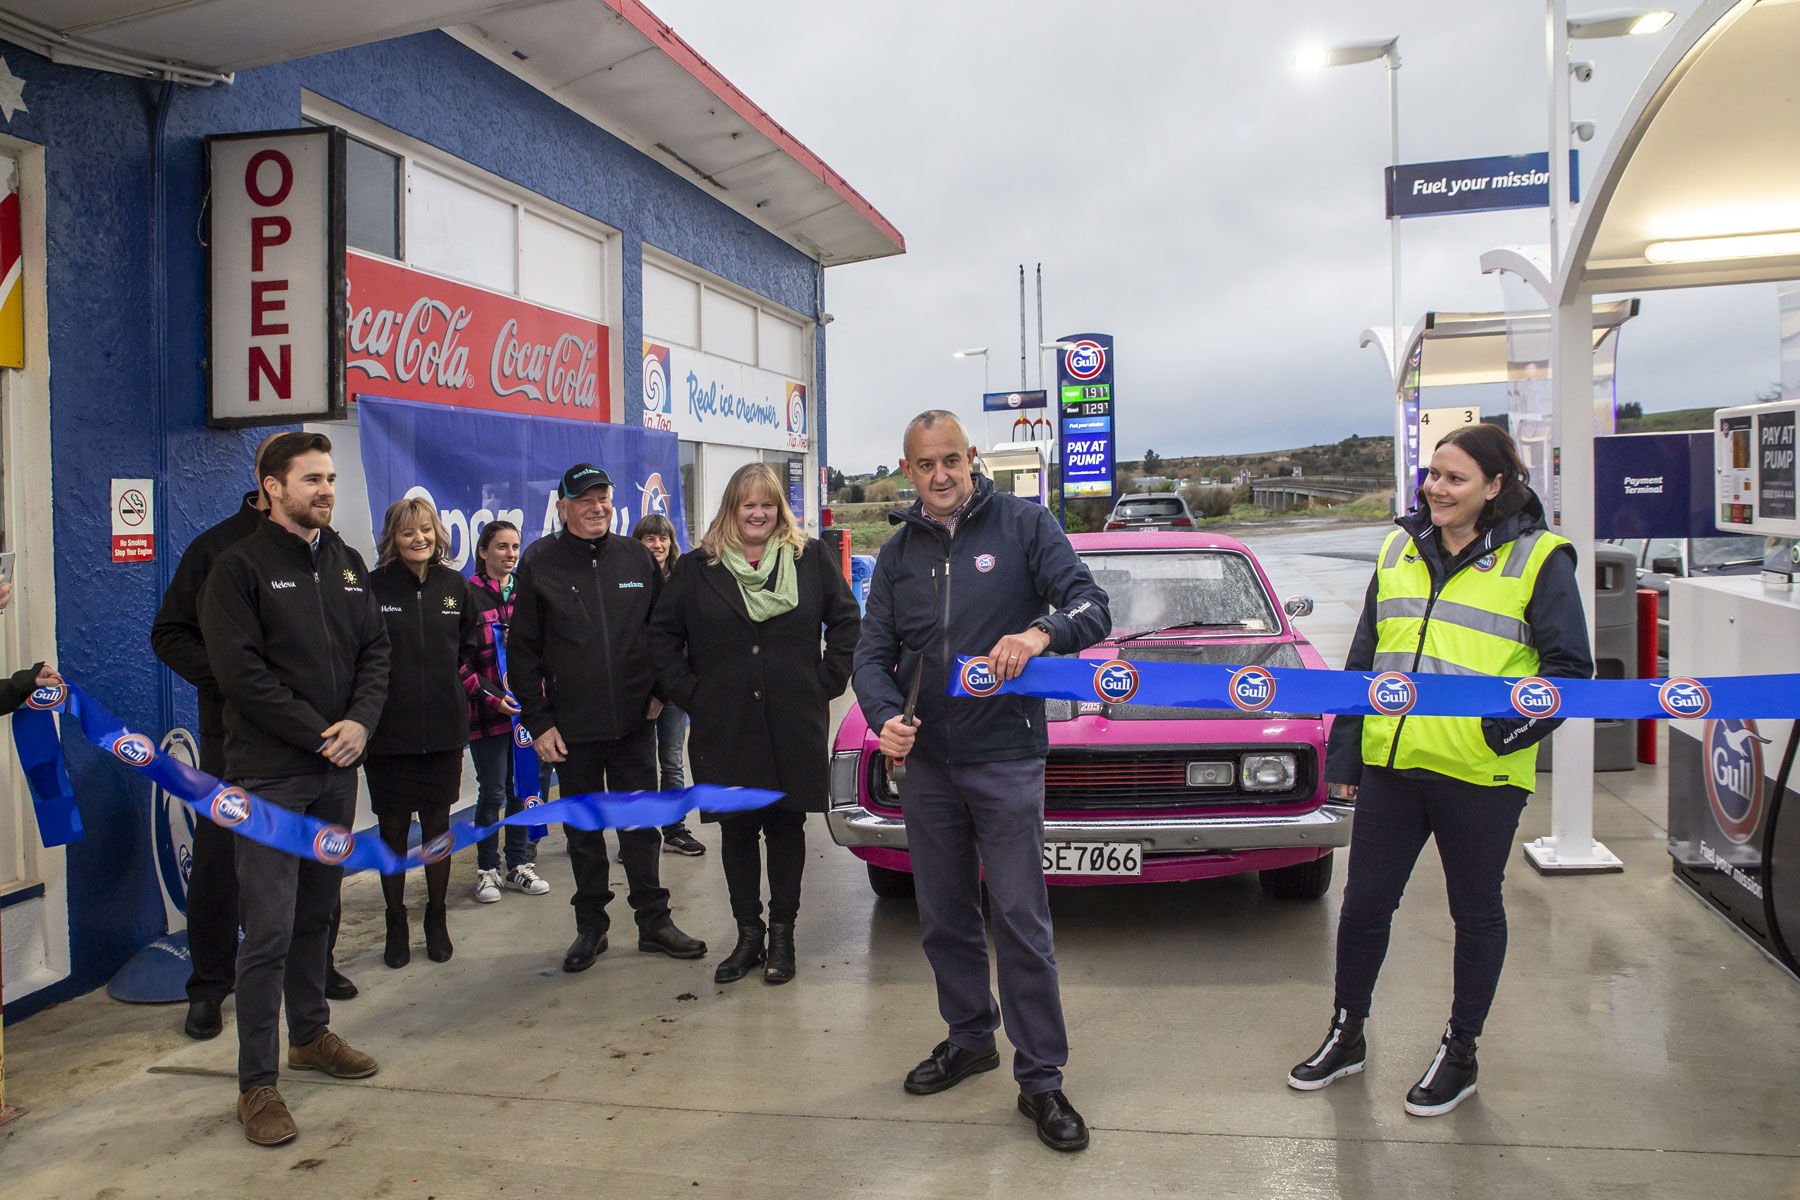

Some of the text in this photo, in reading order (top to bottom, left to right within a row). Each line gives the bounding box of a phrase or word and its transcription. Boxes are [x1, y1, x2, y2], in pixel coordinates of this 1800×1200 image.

[1412, 177, 1447, 195] Fuel
[1448, 176, 1489, 196] your
[245, 149, 294, 402] OPEN
[346, 278, 472, 390] ca-Cola
[490, 318, 599, 409] Coca-Cola
[1072, 355, 1098, 368] Gull
[686, 369, 780, 430] Real ice creamier
[1420, 413, 1430, 425] 4
[1464, 410, 1473, 423] 3
[1761, 424, 1795, 445] PAY AT
[1067, 440, 1107, 453] PAY AT
[1069, 454, 1105, 466] PUMP
[1763, 450, 1794, 469] PUMP
[1623, 475, 1664, 487] Payment
[1623, 485, 1664, 494] Terminal
[128, 539, 148, 548] Smoking
[115, 549, 126, 557] Stop
[137, 548, 152, 557] Engine
[1479, 557, 1493, 567] ull
[968, 673, 997, 685] Gull
[1102, 677, 1131, 690] Gull
[33, 688, 60, 702] Gull
[1237, 684, 1267, 698] Gull
[1377, 690, 1408, 703] Gull
[1520, 694, 1551, 706] Gull
[1668, 694, 1701, 707] Gull
[518, 726, 528, 744] Gull
[119, 743, 146, 763] Gull
[1713, 746, 1752, 801] Gull
[1042, 846, 1137, 871] SE7066
[1700, 839, 1763, 899] Fuel your mission
